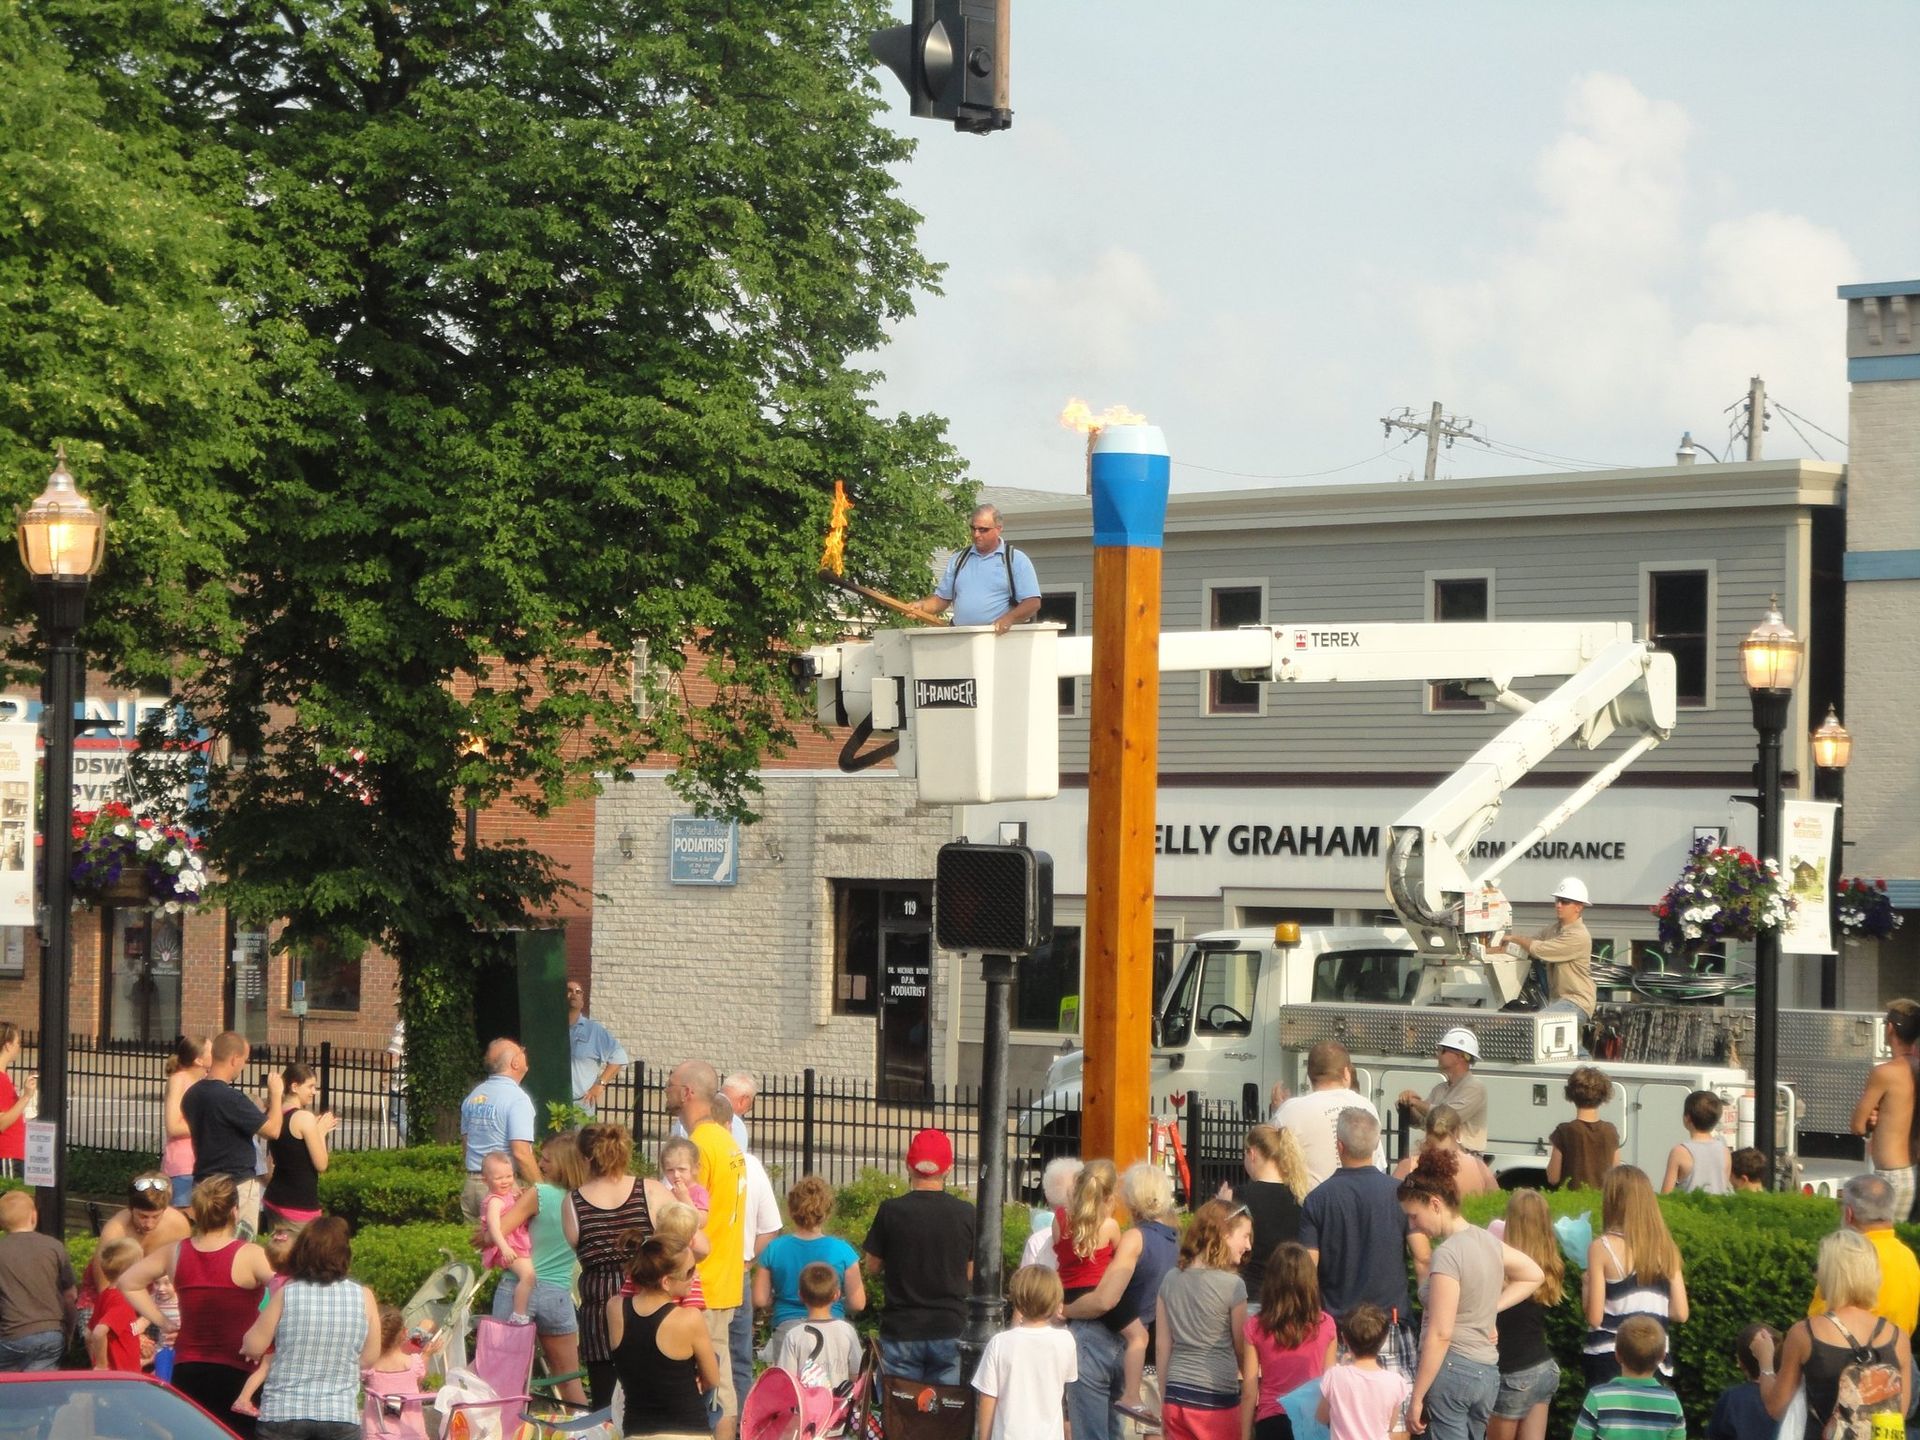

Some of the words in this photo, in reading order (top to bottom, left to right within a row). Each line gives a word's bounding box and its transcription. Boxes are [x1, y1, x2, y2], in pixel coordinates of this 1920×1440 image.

[1311, 632, 1360, 647] TEREX
[915, 680, 975, 708] HI-RANGER
[674, 837, 729, 853] PODIATRIST
[1227, 824, 1380, 857] GRAHAM
[904, 901, 917, 915] 119
[890, 985, 926, 997] PODIATRIST
